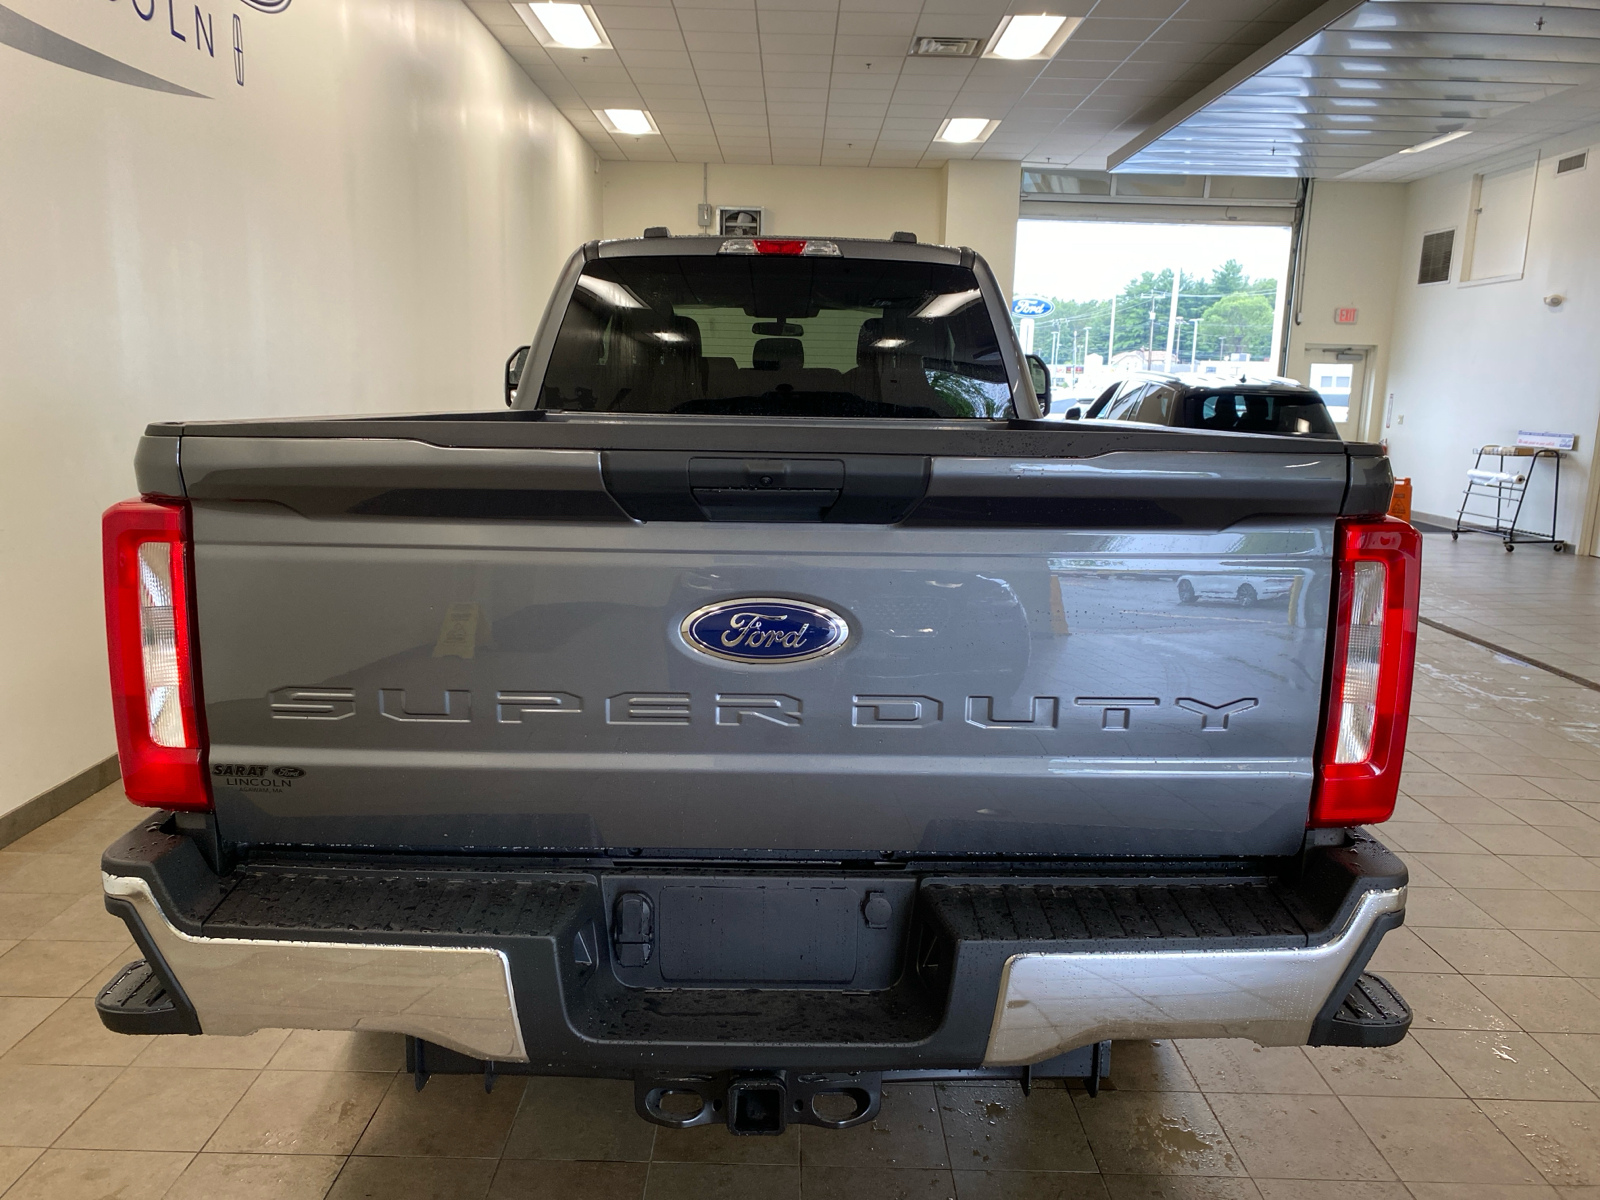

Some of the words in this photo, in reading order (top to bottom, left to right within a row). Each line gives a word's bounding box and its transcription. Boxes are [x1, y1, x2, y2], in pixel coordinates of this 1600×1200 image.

[1014, 299, 1046, 314] Ford
[1338, 307, 1357, 322] EXIT
[720, 611, 810, 648] Ford
[269, 686, 803, 727] SUPER
[851, 693, 1260, 732] DUTY
[213, 763, 268, 777] SARAT
[226, 777, 292, 788] LINCOLN
